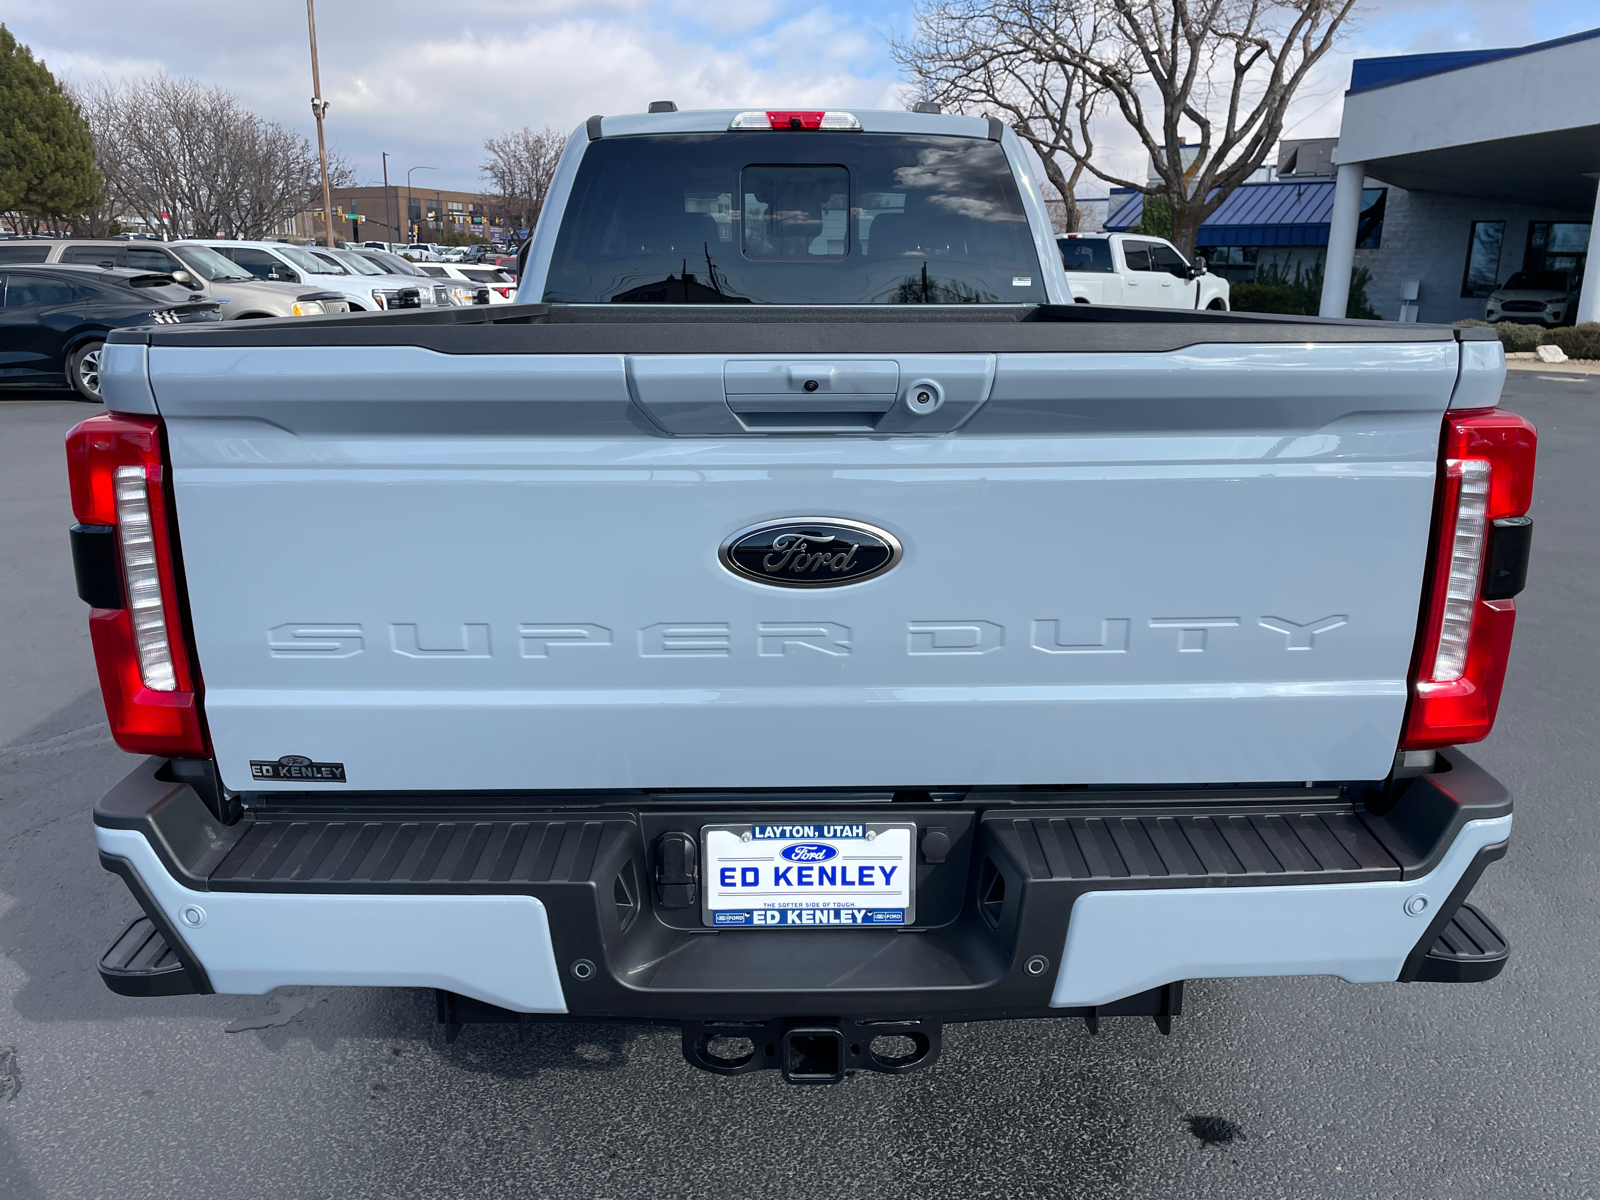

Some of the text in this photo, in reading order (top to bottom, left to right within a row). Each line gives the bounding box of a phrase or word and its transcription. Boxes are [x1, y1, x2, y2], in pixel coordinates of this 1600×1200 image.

[763, 533, 860, 572] Ford
[267, 614, 1348, 659] SUPER DUTY
[252, 765, 342, 778] ED KENLEY
[755, 825, 863, 838] LAYTON, UTAH
[791, 845, 826, 861] Ford
[720, 866, 898, 887] ED KENLEY
[753, 910, 867, 924] ED KENLEY
